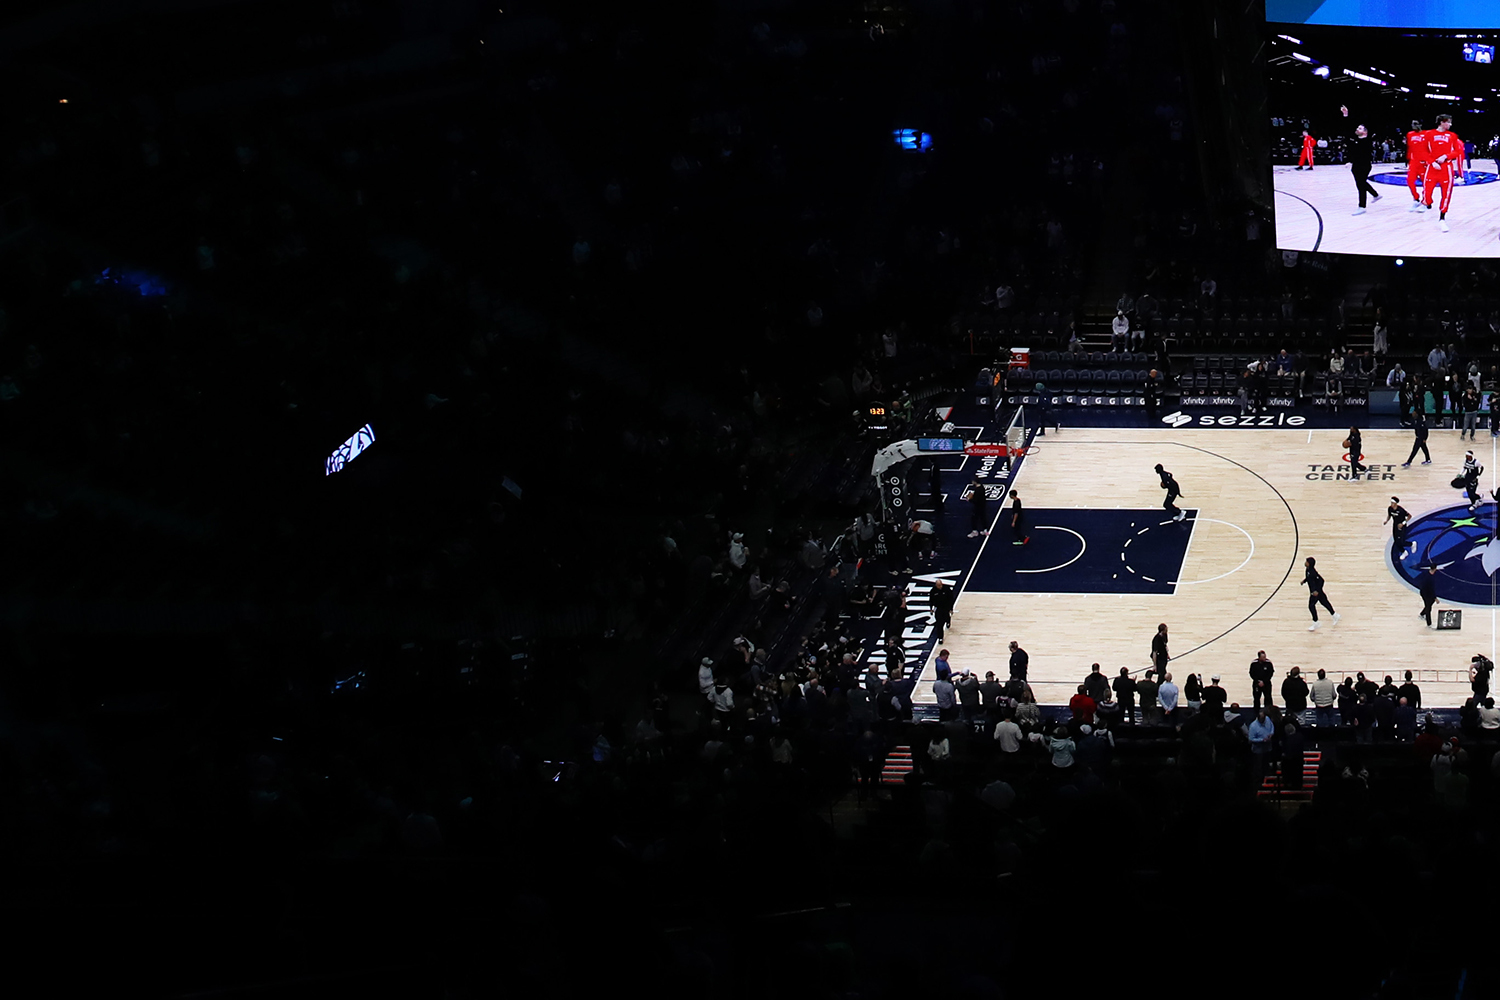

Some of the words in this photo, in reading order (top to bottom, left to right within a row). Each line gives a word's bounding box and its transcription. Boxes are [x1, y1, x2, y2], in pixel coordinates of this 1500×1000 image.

[1016, 353, 1022, 361] G
[1022, 396, 1029, 404] G
[1182, 396, 1206, 406] xfinity
[1212, 396, 1235, 406] xfinity
[1269, 397, 1292, 407] xfinity
[1199, 411, 1306, 426] sezzle
[1308, 464, 1397, 472] TARET
[974, 724, 985, 733] 21
